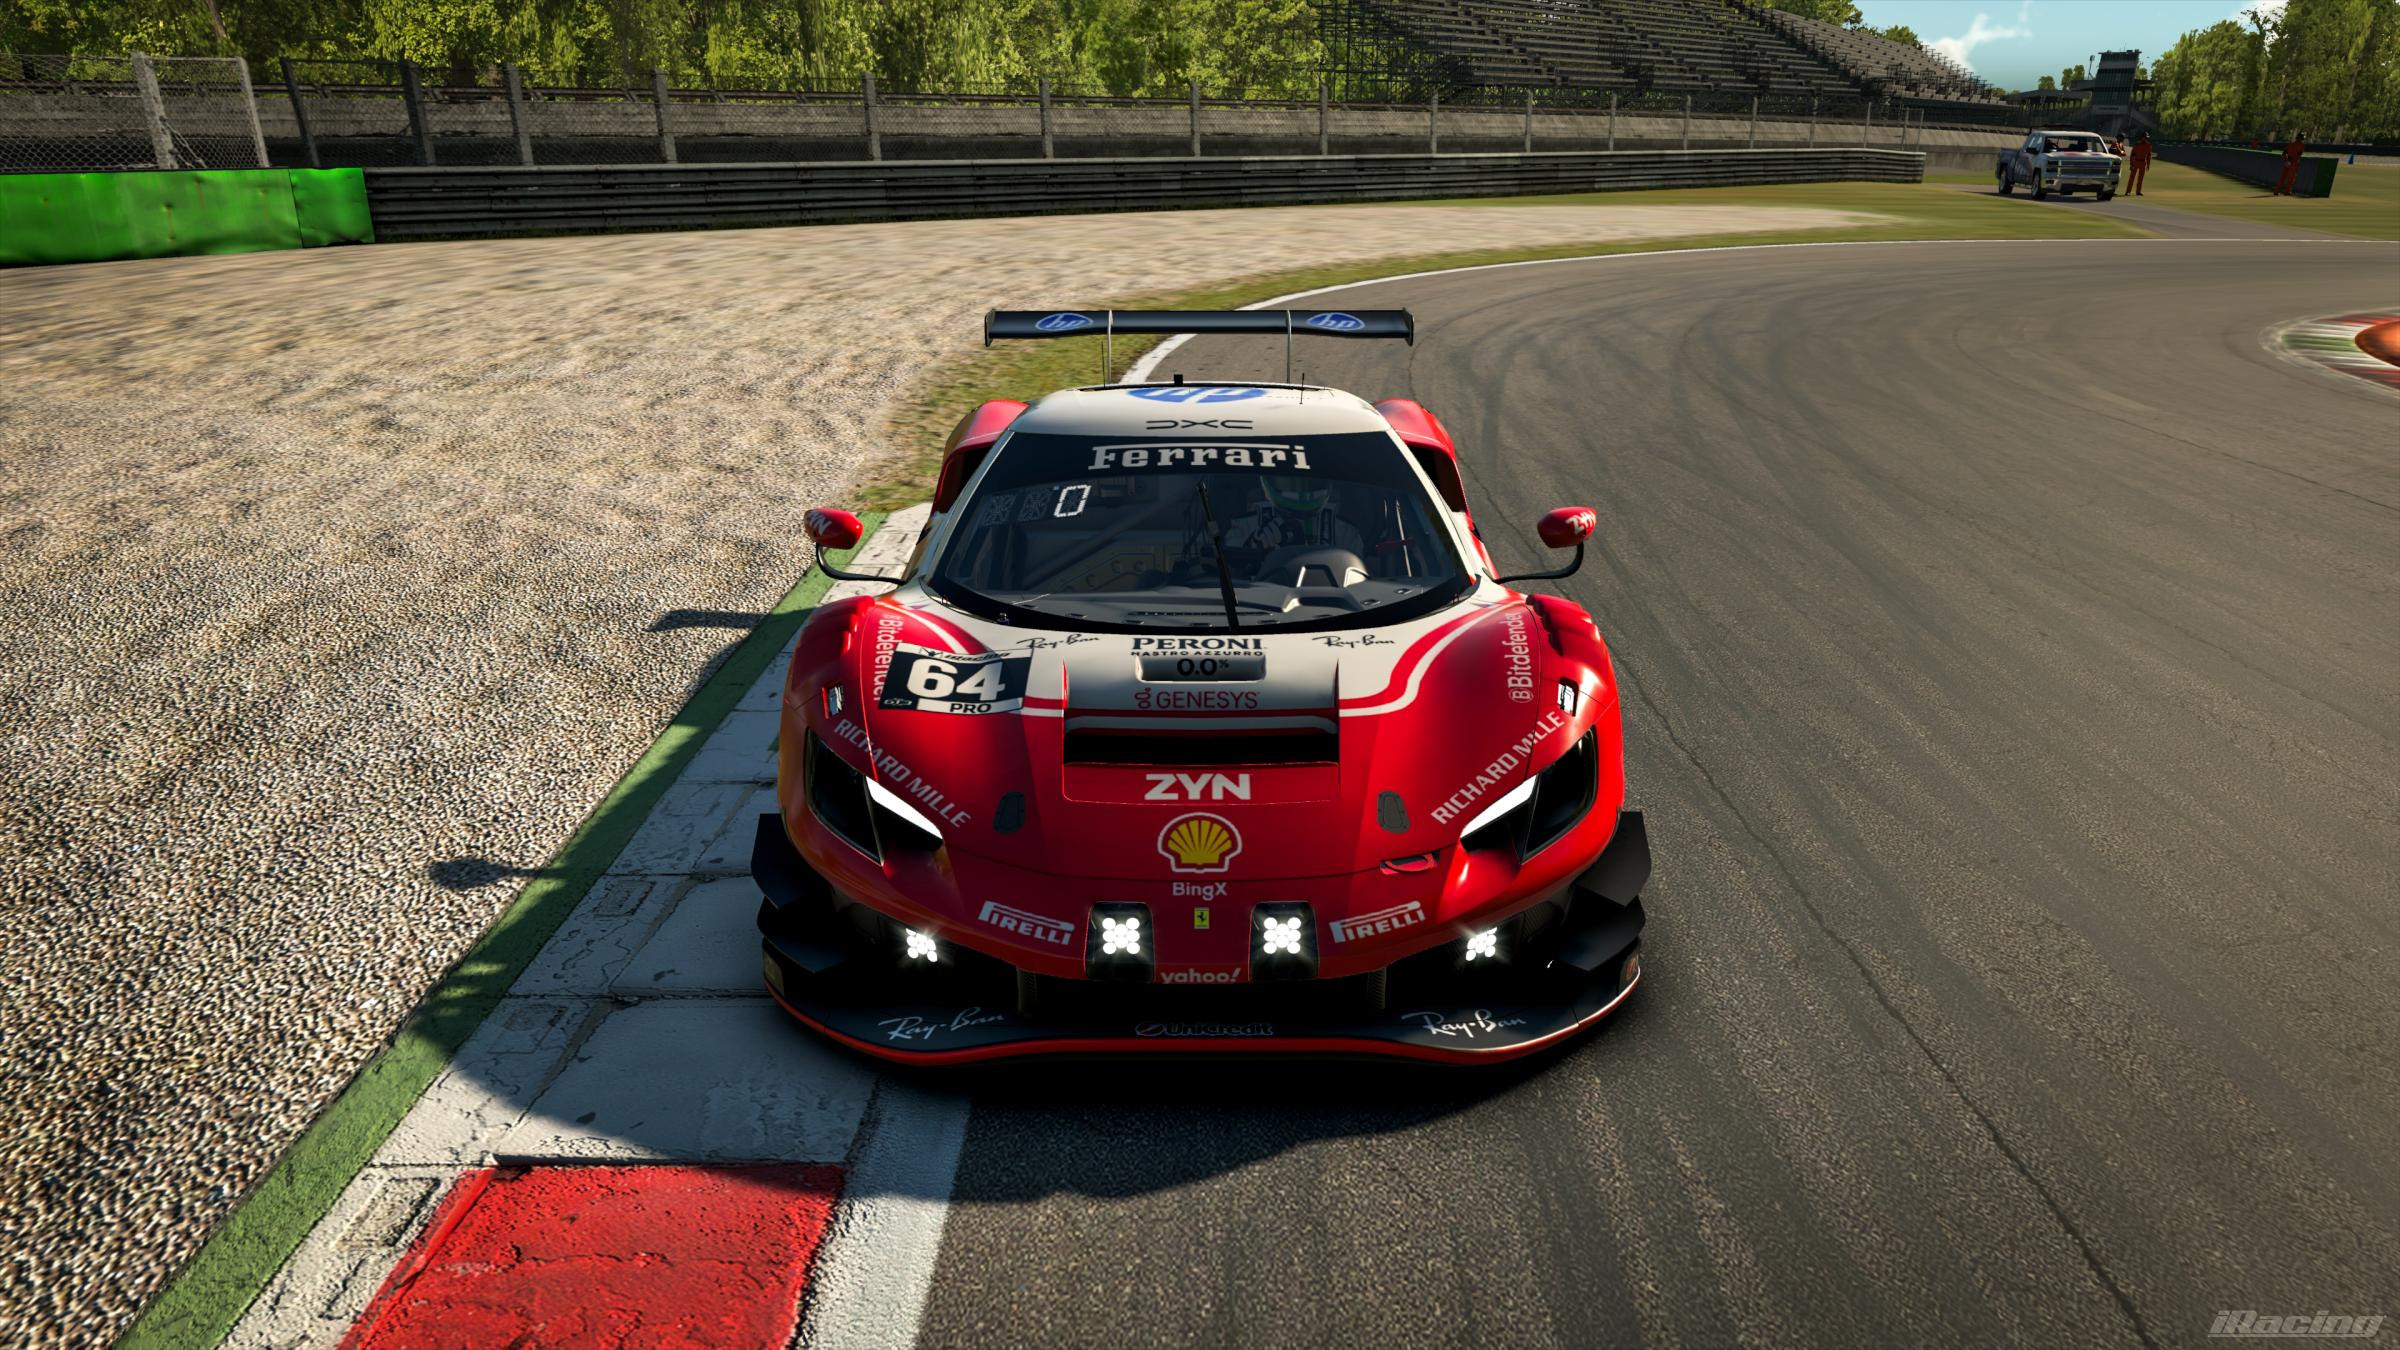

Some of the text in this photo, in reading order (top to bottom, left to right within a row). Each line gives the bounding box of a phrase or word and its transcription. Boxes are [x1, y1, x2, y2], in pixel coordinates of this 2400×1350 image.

[1042, 313, 1089, 331] hp
[1313, 313, 1360, 330] hp
[1088, 442, 1311, 469] Ferrari
[1016, 634, 1099, 648] Ray-Ban
[1132, 638, 1262, 650] PERONI
[1312, 634, 1394, 648] Ray-Ban
[1499, 612, 1533, 688] Bitdefender
[1176, 658, 1230, 676] 0.0%
[907, 658, 1006, 701] 64
[950, 703, 992, 714] PRO
[1156, 691, 1259, 709] GENESYS
[834, 718, 972, 828] RICHARD MILLE
[1430, 711, 1566, 825] RICHARD MILLE
[1144, 773, 1251, 800] ZYN
[1172, 881, 1228, 901] BingX
[978, 900, 1075, 945] PIRELLI
[1328, 900, 1426, 943] PIRELLI
[1161, 967, 1241, 984] yahoo!
[877, 1006, 1004, 1040] Ray-Ban
[1166, 1022, 1274, 1036] UniCredit
[1402, 1008, 1527, 1037] Ray-Ban
